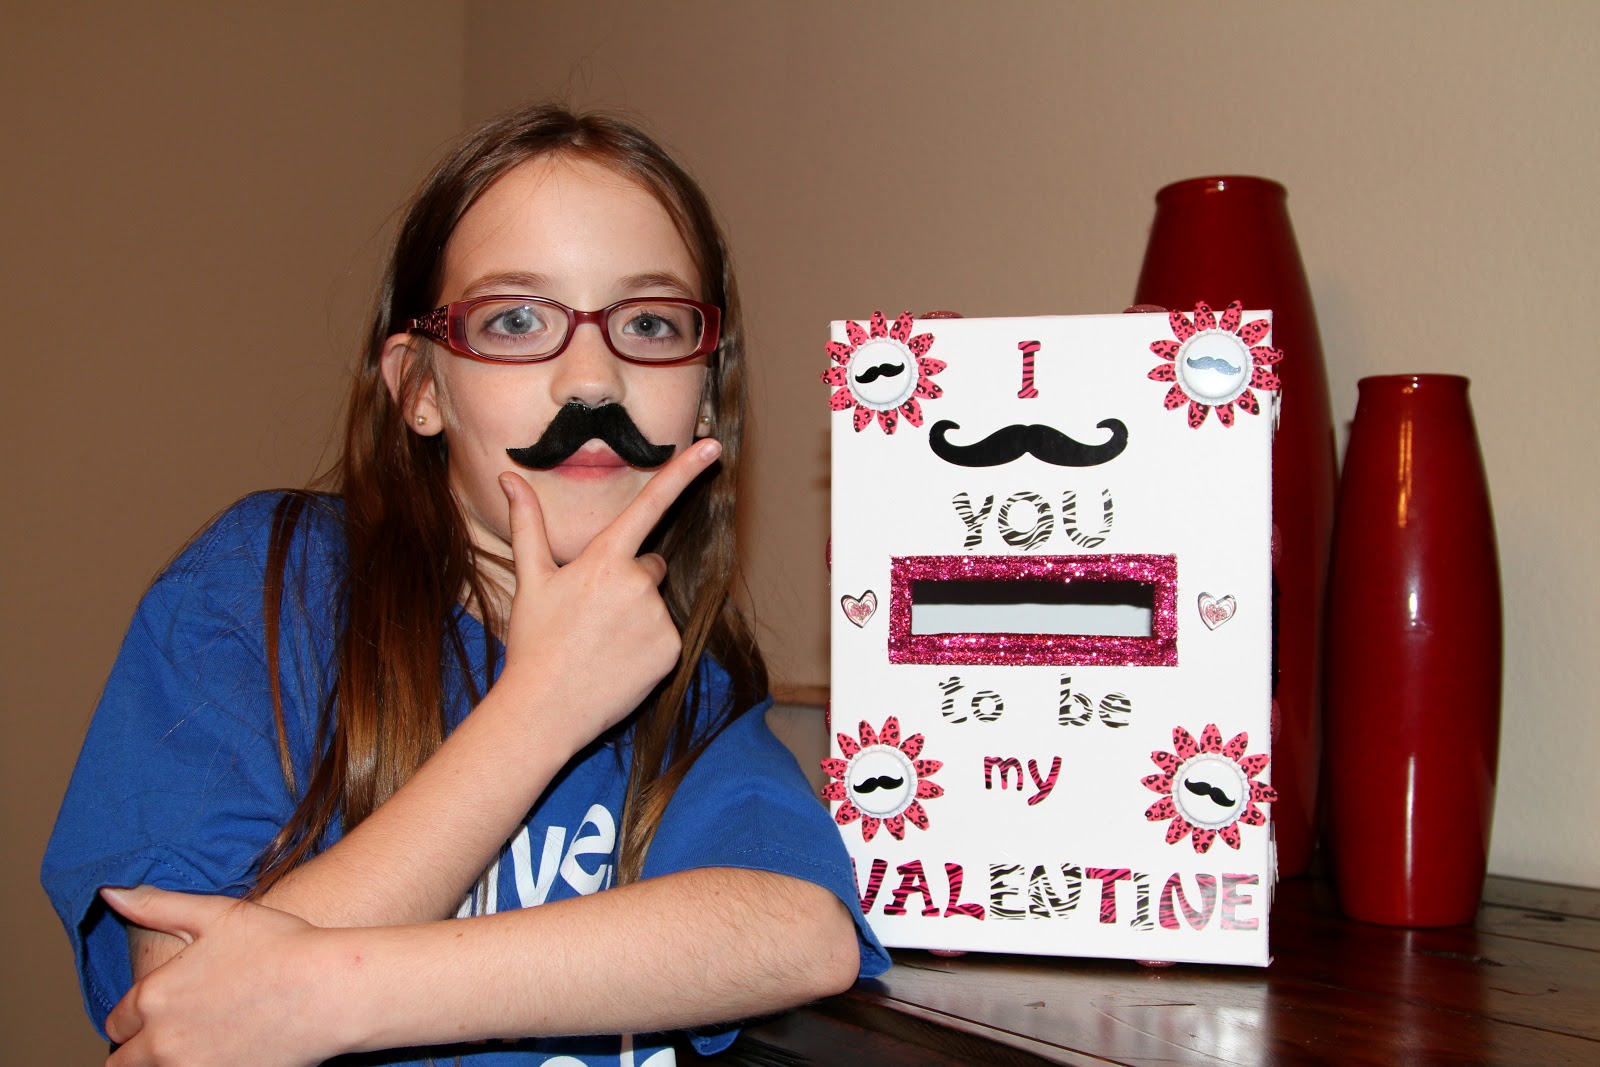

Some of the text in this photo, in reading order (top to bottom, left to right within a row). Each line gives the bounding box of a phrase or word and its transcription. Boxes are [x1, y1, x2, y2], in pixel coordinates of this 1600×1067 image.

[1017, 340, 1041, 399] I
[952, 488, 1114, 551] YOU
[938, 673, 1132, 728] to be
[983, 755, 1062, 806] my
[850, 857, 1260, 932] VALENTINE
